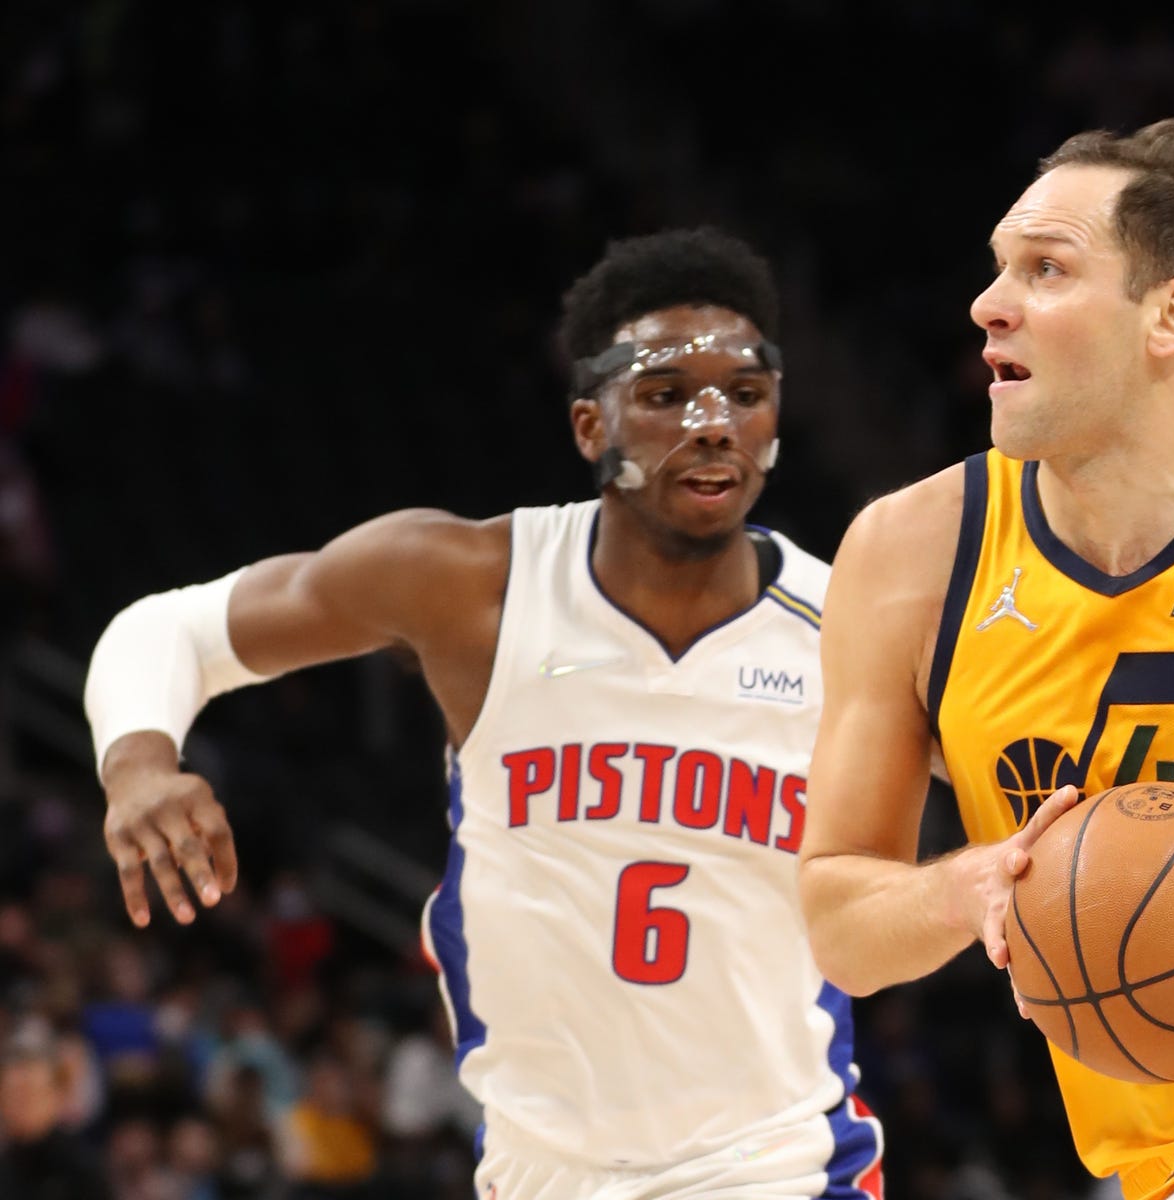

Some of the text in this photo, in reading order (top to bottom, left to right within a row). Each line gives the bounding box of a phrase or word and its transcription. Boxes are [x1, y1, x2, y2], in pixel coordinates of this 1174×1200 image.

[739, 666, 803, 696] UWM
[502, 742, 808, 854] PISTONS
[612, 860, 690, 986] 6
